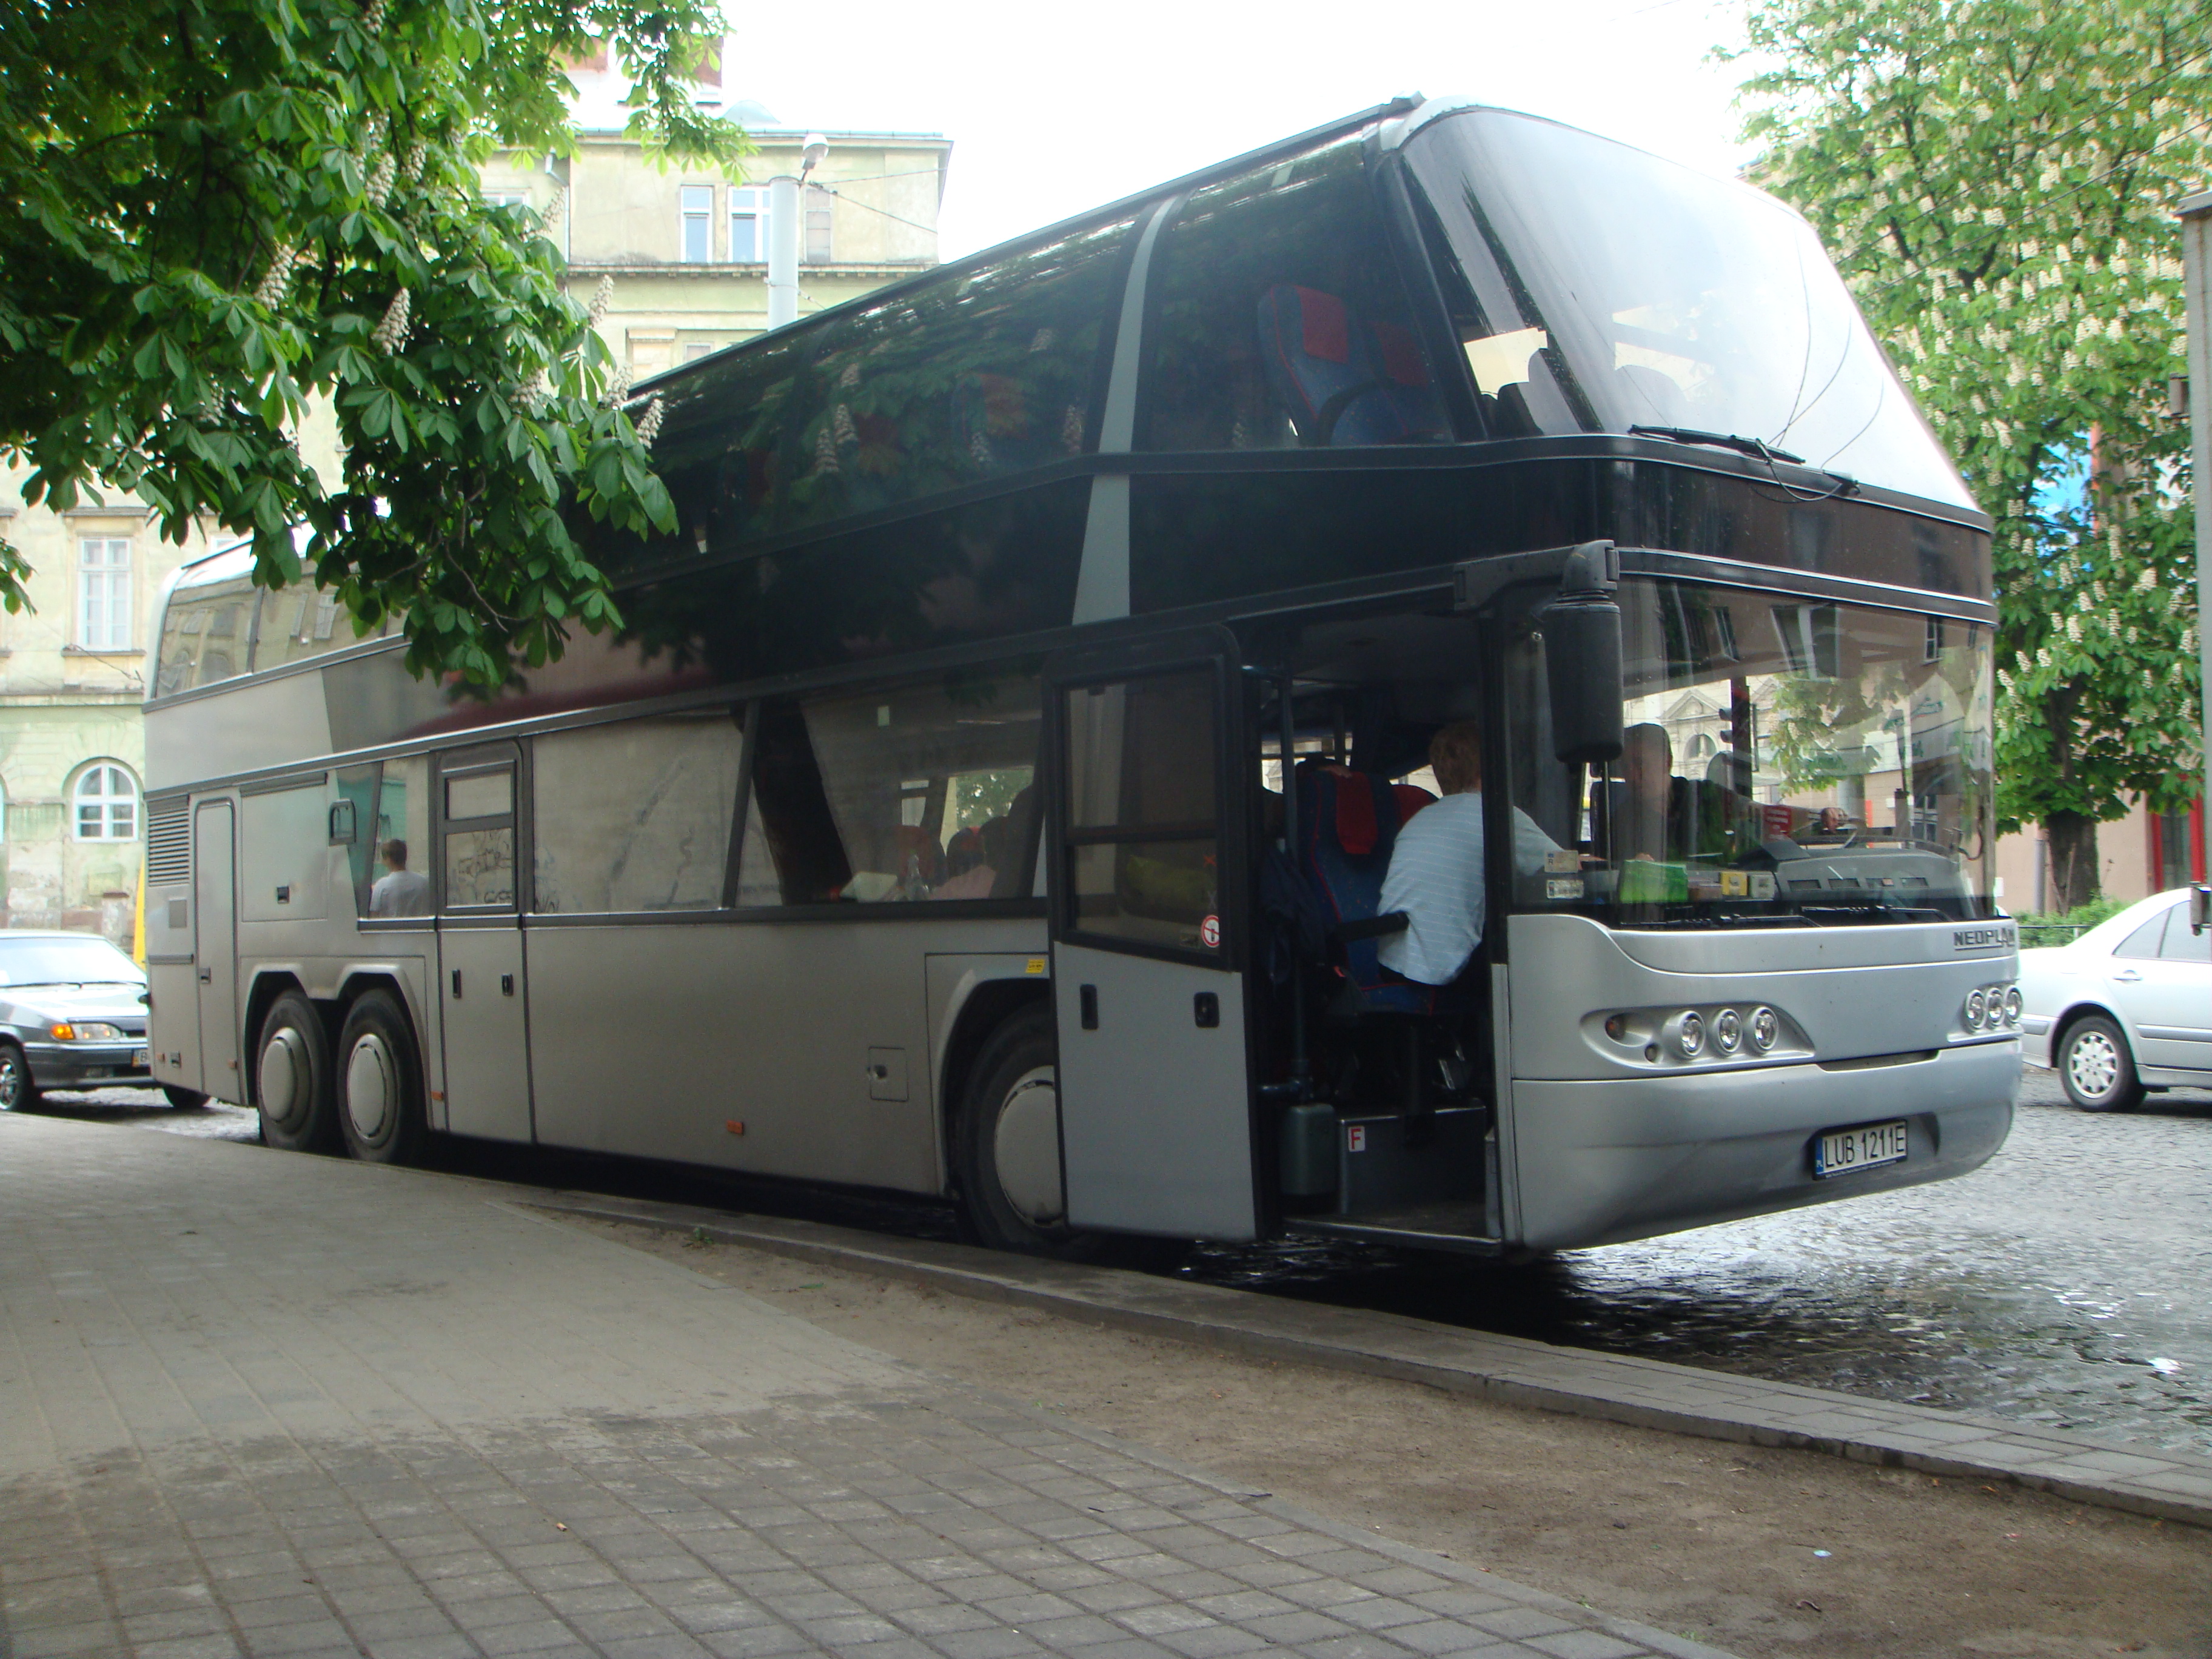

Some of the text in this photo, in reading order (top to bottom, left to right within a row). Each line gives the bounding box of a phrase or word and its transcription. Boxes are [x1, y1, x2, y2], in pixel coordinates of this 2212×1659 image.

[1953, 928, 2015, 948] NEOPLAN
[1351, 1128, 1361, 1150] F
[1825, 1125, 1905, 1167] LUB 1211E
